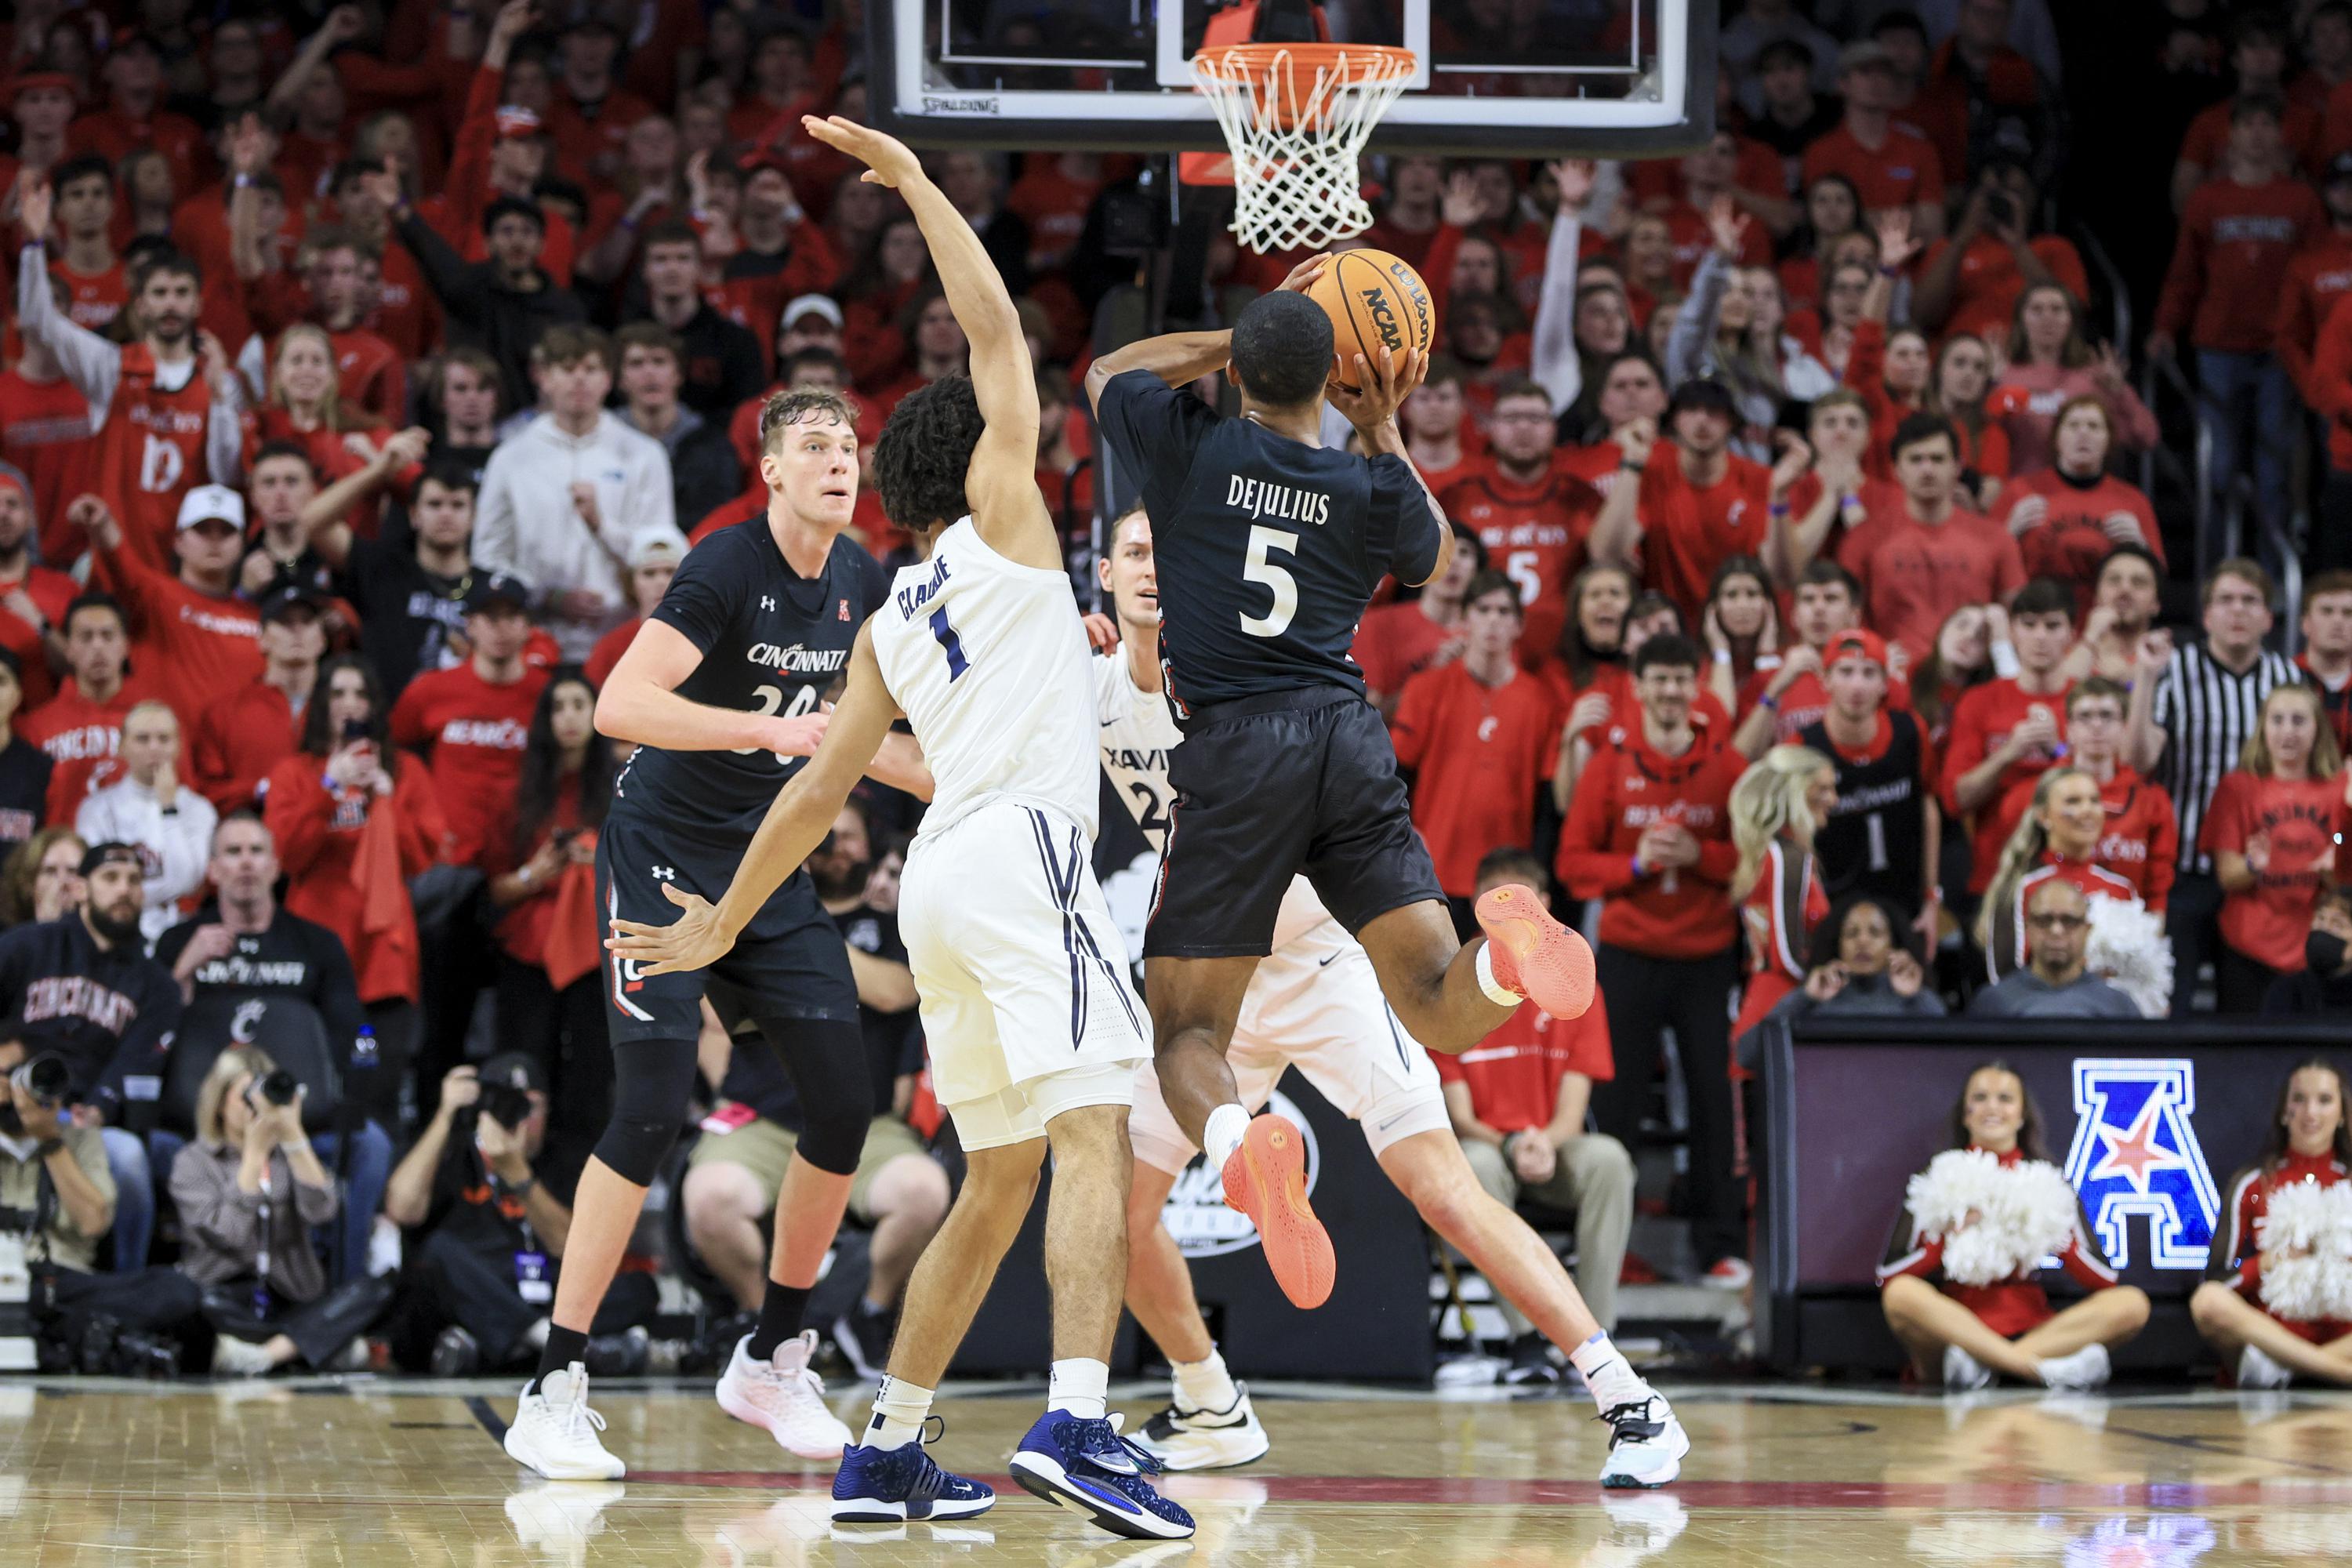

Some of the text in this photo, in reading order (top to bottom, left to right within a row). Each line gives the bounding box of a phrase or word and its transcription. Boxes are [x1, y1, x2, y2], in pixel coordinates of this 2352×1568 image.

[921, 96, 1000, 114] SPALDING
[1362, 288, 1403, 353] NCAA
[1226, 474, 1330, 525] DEJULIUS
[1239, 524, 1299, 637] 5
[1506, 551, 1542, 608] 5
[747, 643, 848, 673] CINCINNATI
[929, 601, 971, 684] 1
[1101, 746, 1167, 771] XAVI
